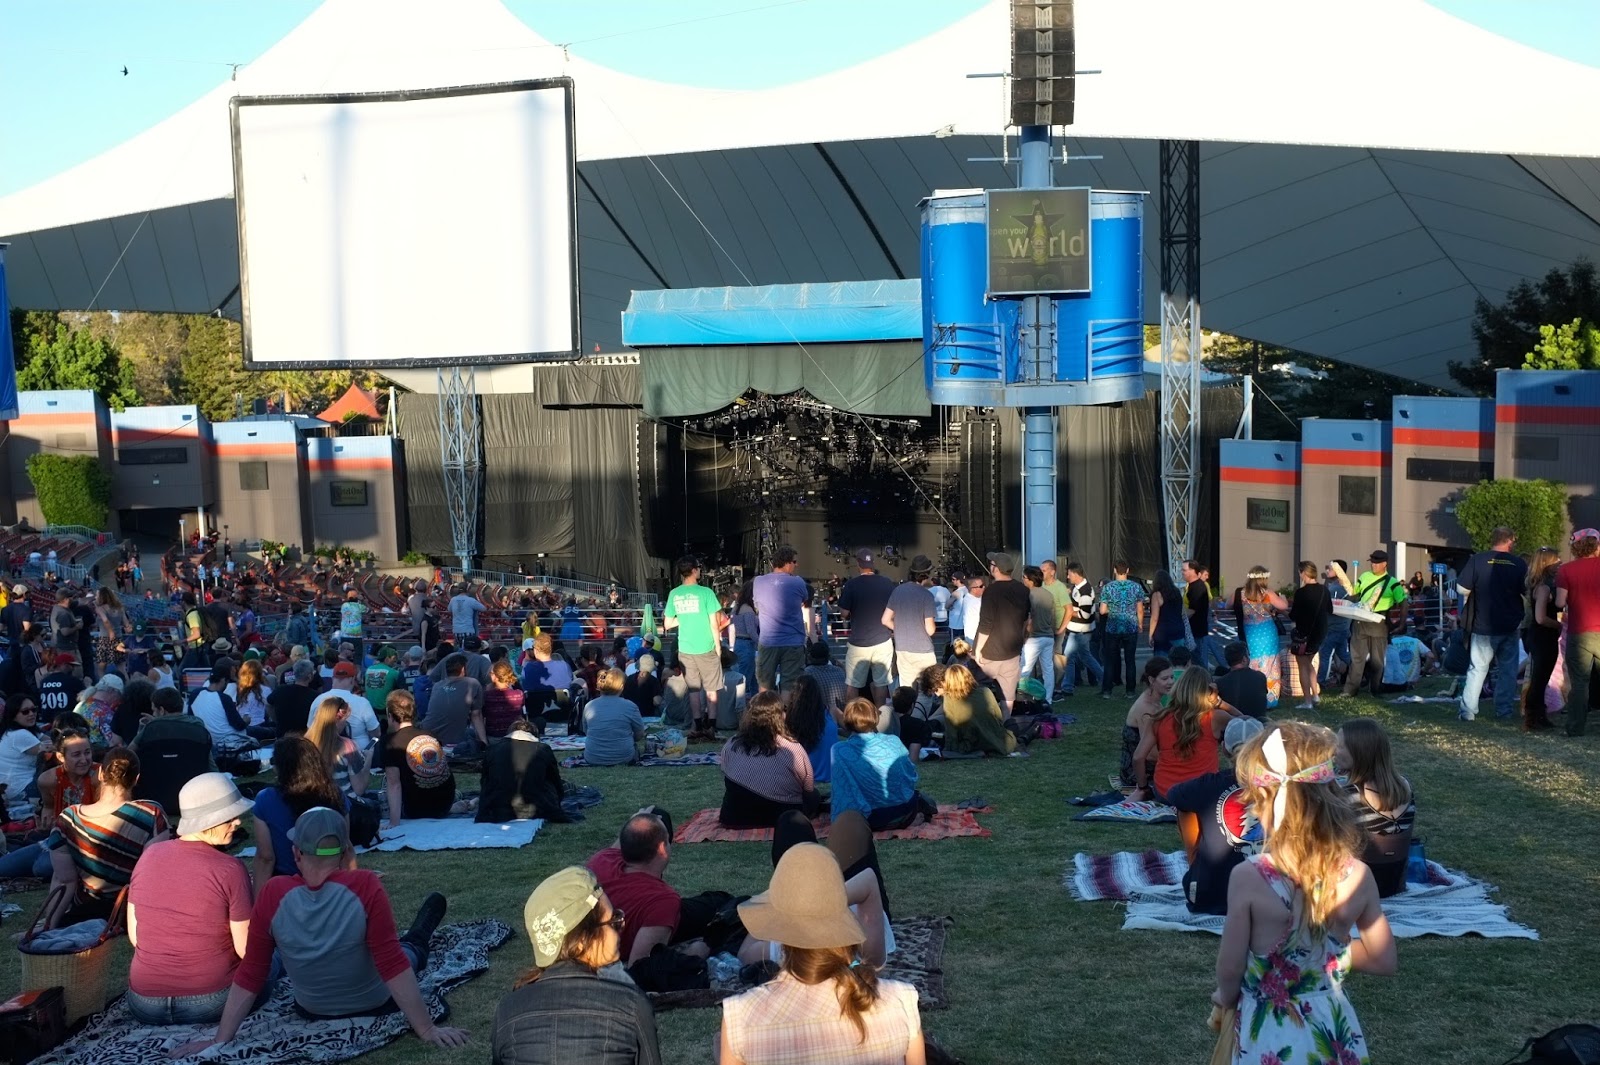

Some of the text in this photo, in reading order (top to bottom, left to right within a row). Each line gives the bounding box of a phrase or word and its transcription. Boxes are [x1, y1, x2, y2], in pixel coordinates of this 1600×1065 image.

[1009, 227, 1027, 236] your
[1008, 229, 1084, 257] wrld
[40, 692, 68, 709] 209
